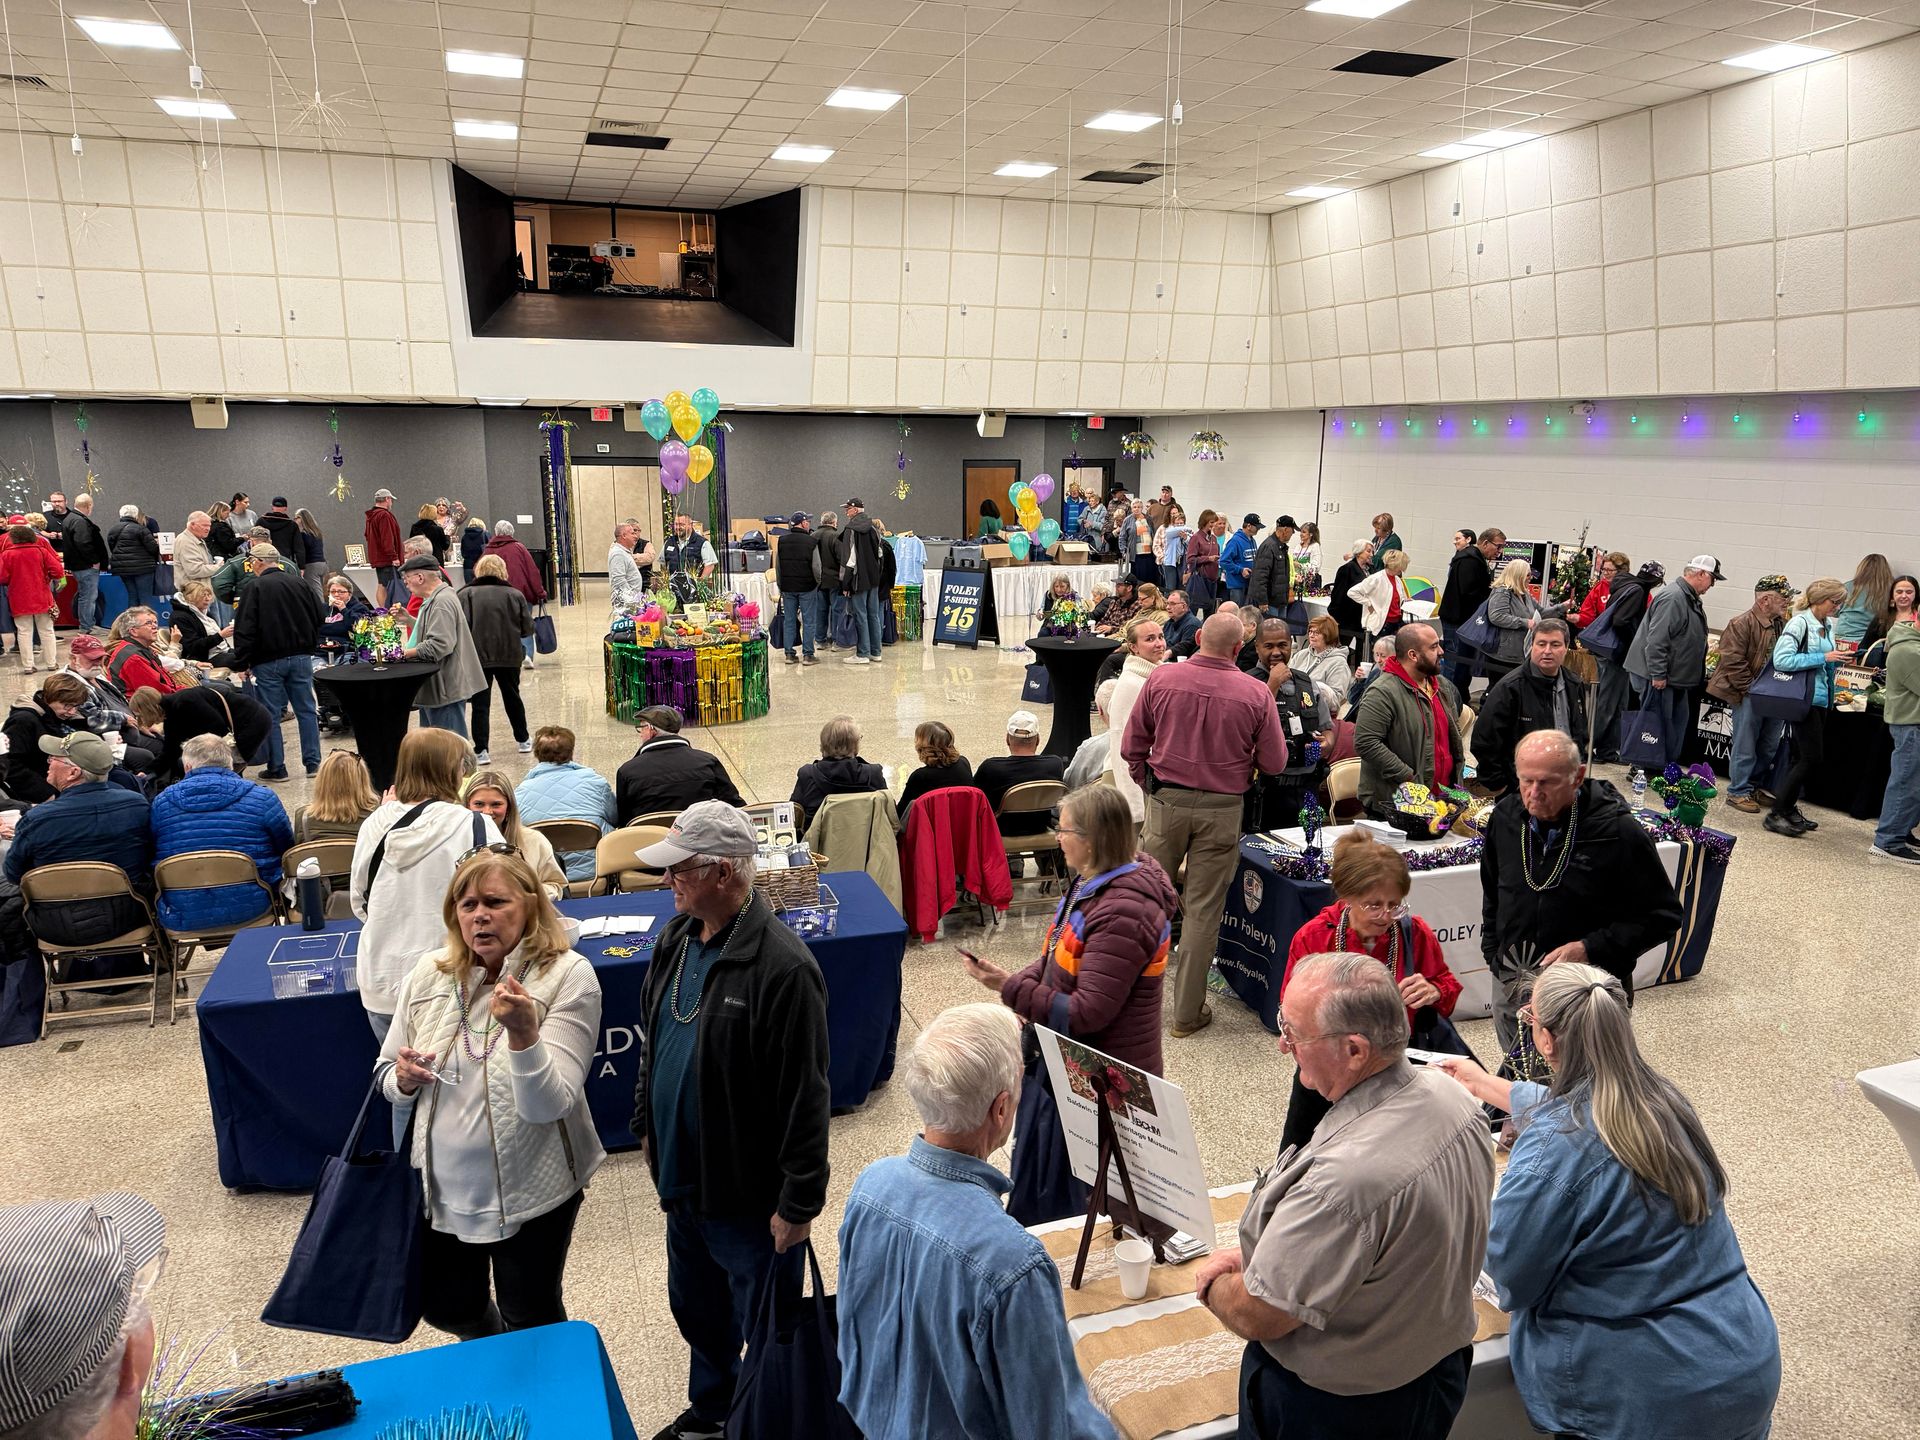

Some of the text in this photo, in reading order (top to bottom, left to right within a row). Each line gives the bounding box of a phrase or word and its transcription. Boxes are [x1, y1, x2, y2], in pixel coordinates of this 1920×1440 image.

[944, 584, 980, 596] FOLEY
[944, 595, 979, 606] T-SHIRTS
[942, 605, 977, 629] $15
[1835, 669, 1853, 677] FARM
[1697, 730, 1728, 743] FARMERS
[1704, 740, 1732, 761] MA
[1241, 918, 1268, 946] Foley
[1434, 924, 1475, 943] OLEY
[1066, 1096, 1092, 1114] Baldwin
[1117, 1121, 1146, 1140] Heritage
[1147, 1136, 1178, 1156] Museum
